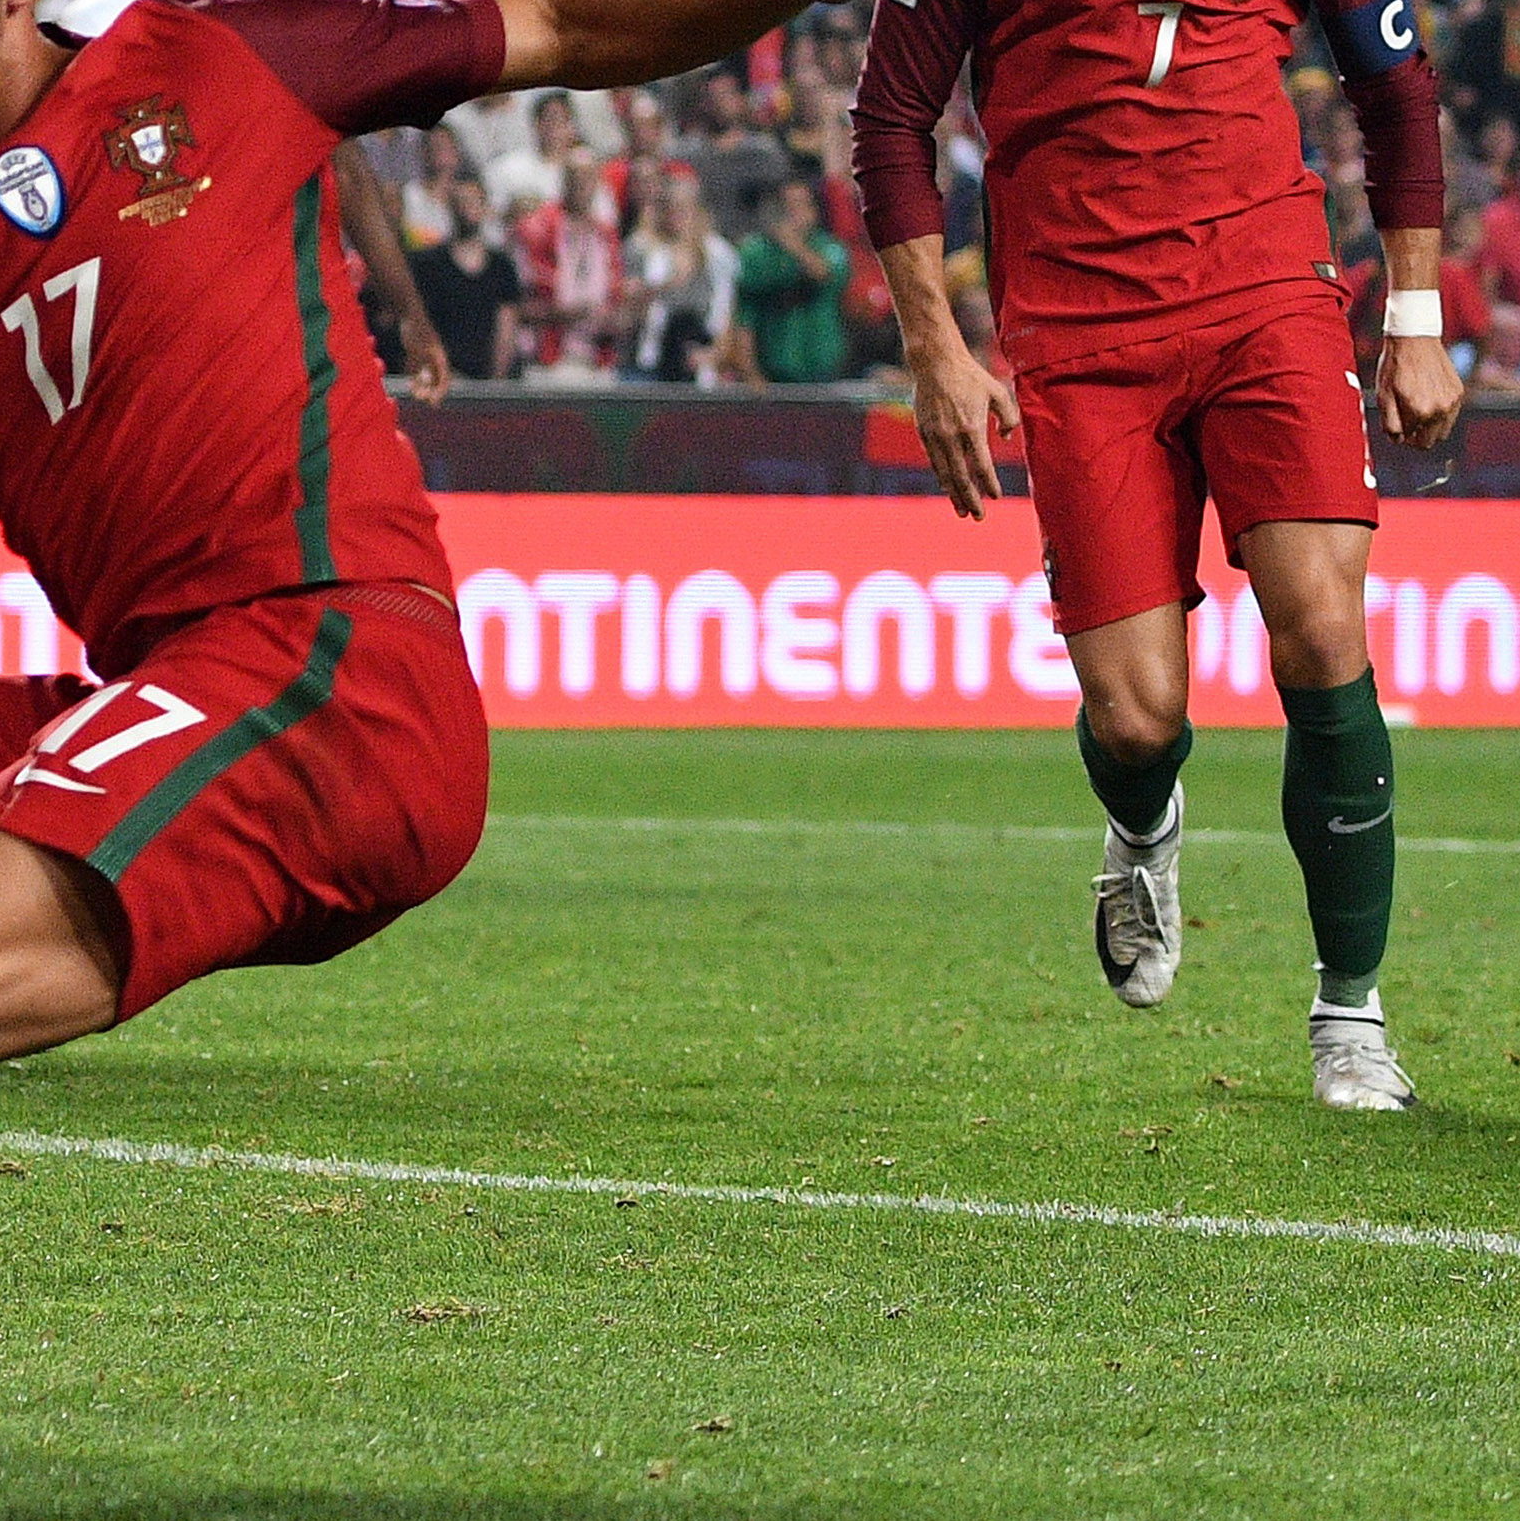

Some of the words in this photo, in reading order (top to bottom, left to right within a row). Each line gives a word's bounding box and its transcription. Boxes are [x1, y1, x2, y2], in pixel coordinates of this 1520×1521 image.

[1137, 1, 1185, 88] 7
[0, 256, 102, 426] 17
[455, 567, 1083, 701] NTINENTE
[36, 681, 208, 773] 17
